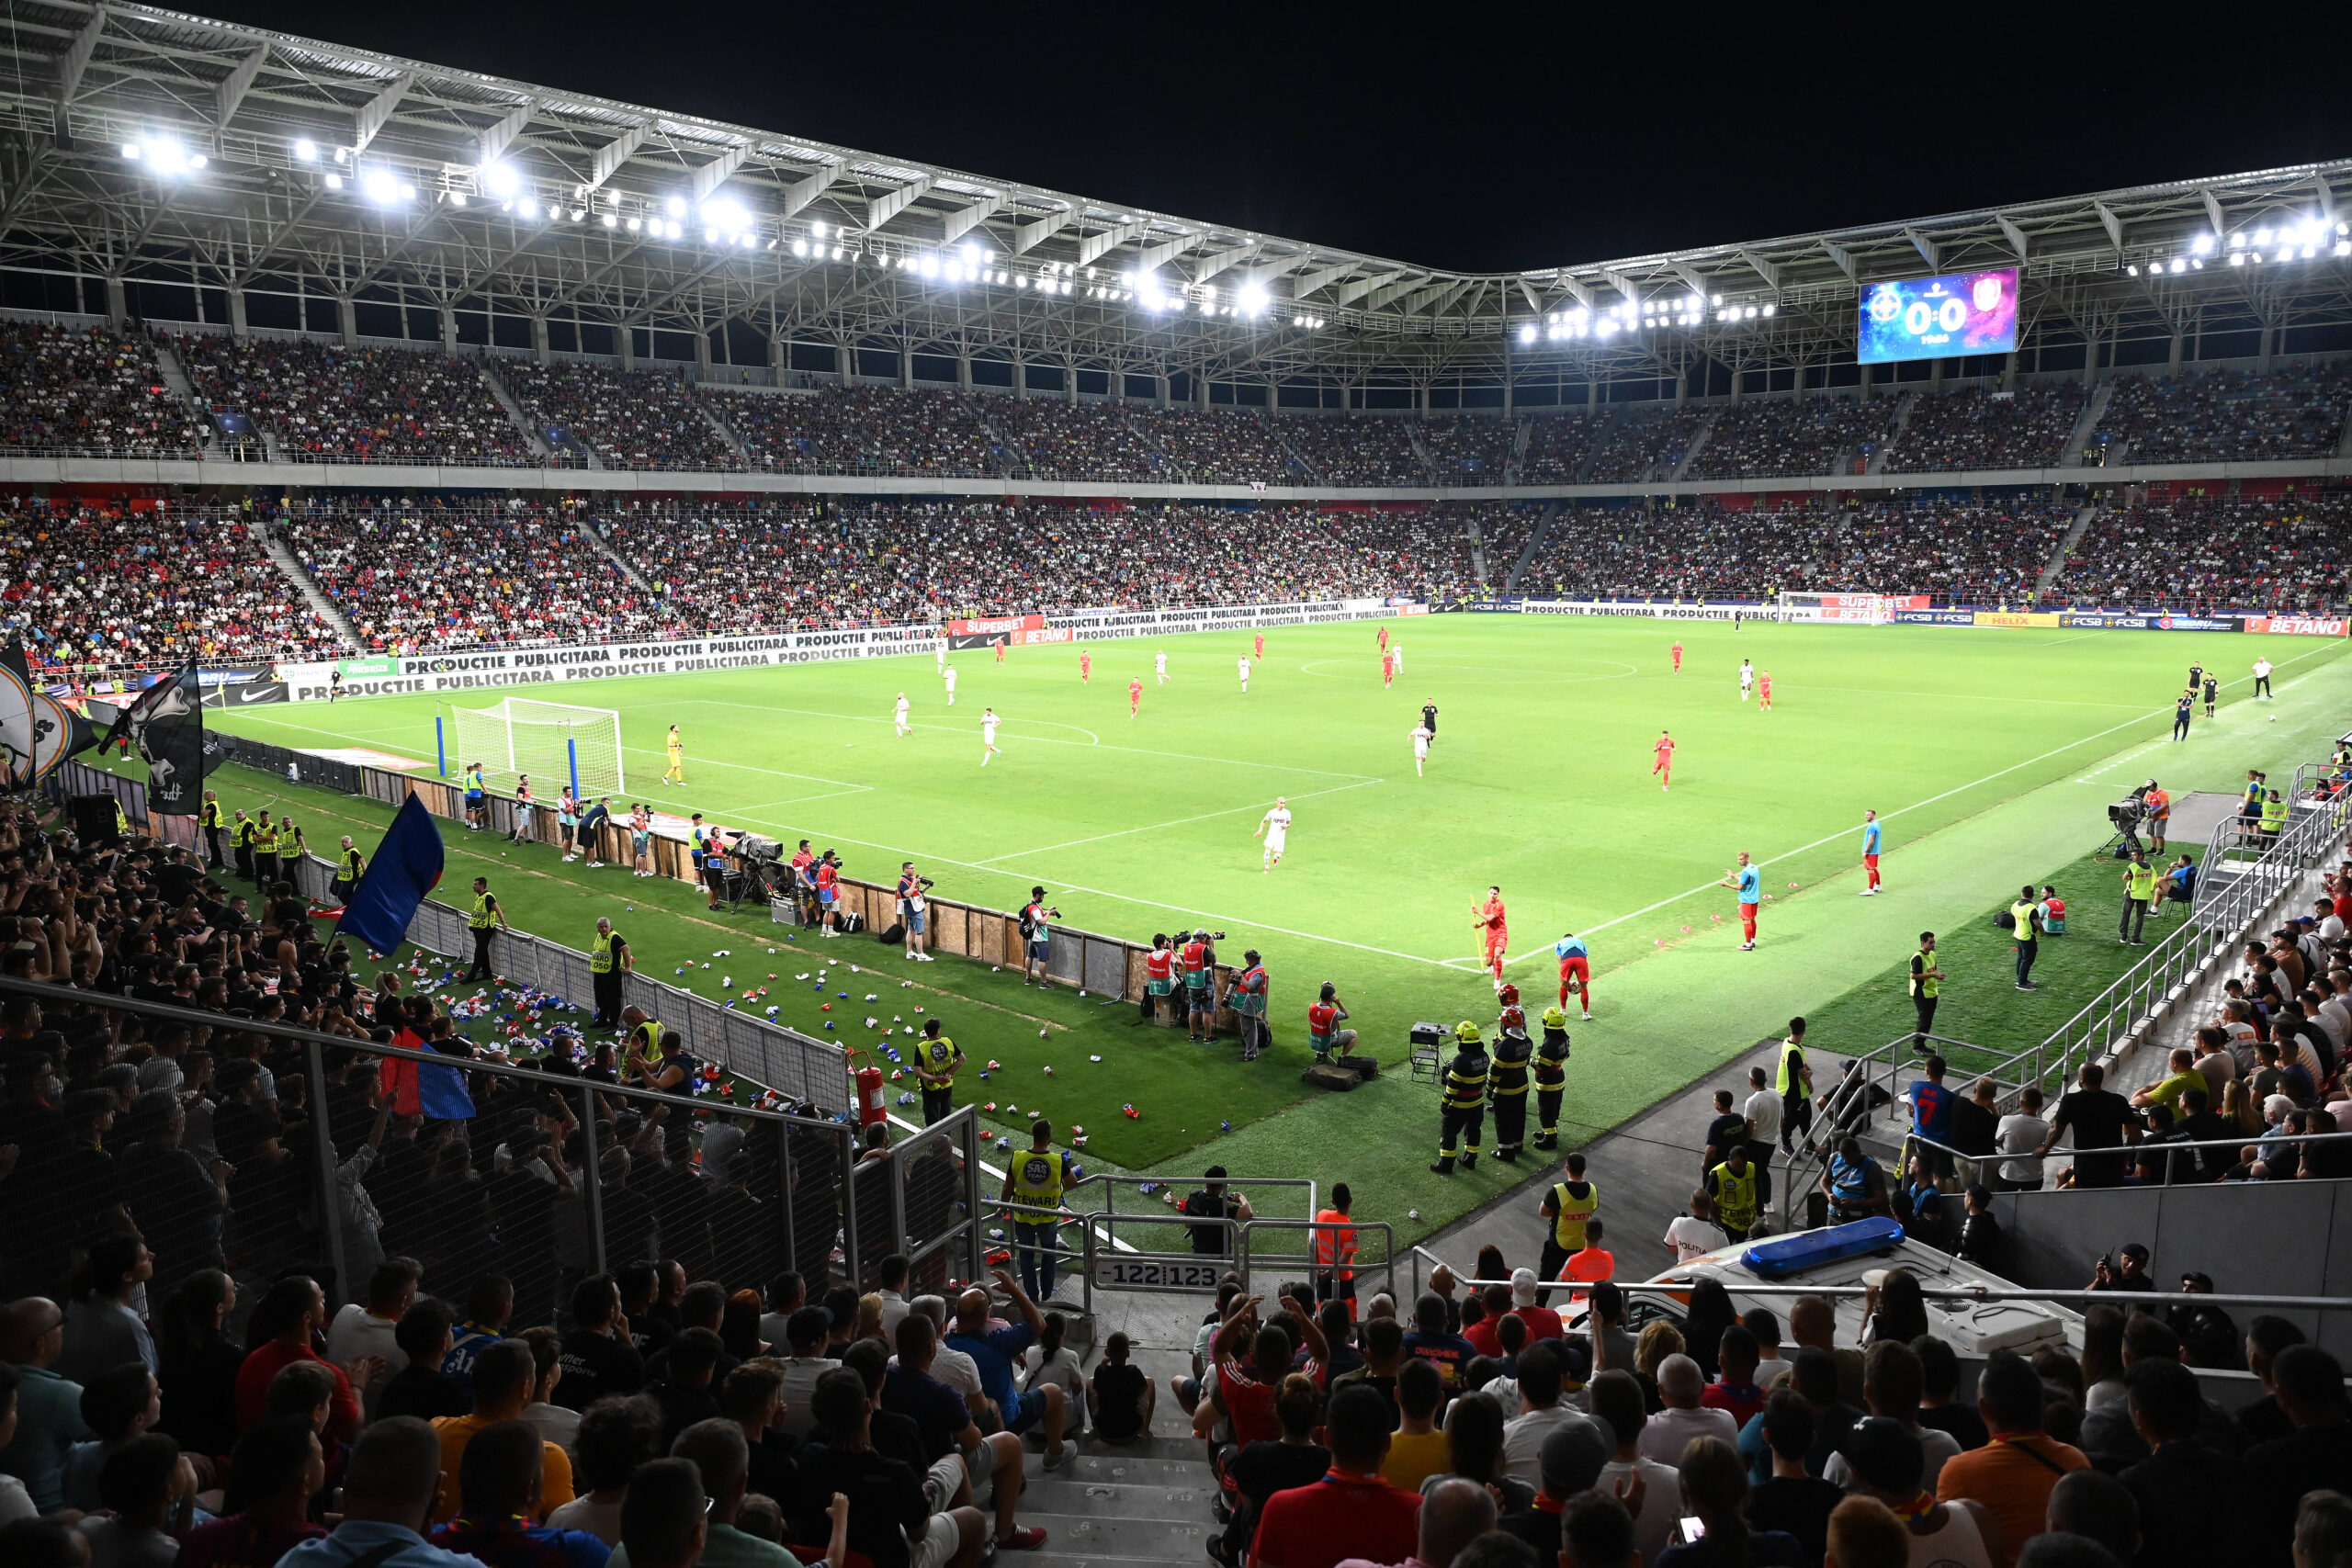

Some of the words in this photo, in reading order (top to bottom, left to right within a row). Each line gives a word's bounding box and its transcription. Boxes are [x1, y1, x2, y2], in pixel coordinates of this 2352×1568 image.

[1161, 610, 1208, 623] PRODUCTIE
[1260, 604, 1301, 616] PRODUCTIE
[1474, 603, 1494, 612] FCSB
[1501, 603, 1521, 612] FCSB
[1525, 605, 1584, 615] PRODUCTIE
[1663, 609, 1730, 619] PRODUCTIE
[967, 617, 1025, 634] SUPERBET
[1077, 627, 1136, 641] PRODUCTIE
[1202, 618, 1251, 631] PRODUCTIE
[1309, 611, 1352, 623] PRODUCTIE
[1903, 614, 1932, 622] FCSB
[1942, 615, 1973, 623] FCSB
[1992, 617, 2030, 626] HELIX
[2071, 618, 2103, 626] FCSB
[2115, 619, 2147, 627] FCSB
[1025, 628, 1069, 644] BETANO
[2268, 621, 2341, 635] BETANO
[619, 644, 702, 660] PRODUCTIE
[796, 633, 865, 648] PRODUCTIE
[566, 662, 666, 680] PRODUCTIE
[778, 648, 861, 663] PRODUCTIE
[868, 642, 936, 657] PUBLICITAR
[1917, 1098, 1937, 1125] 7
[1026, 1162, 1048, 1174] SAS
[1114, 1265, 1159, 1284] 122
[1170, 1267, 1216, 1286] 123
